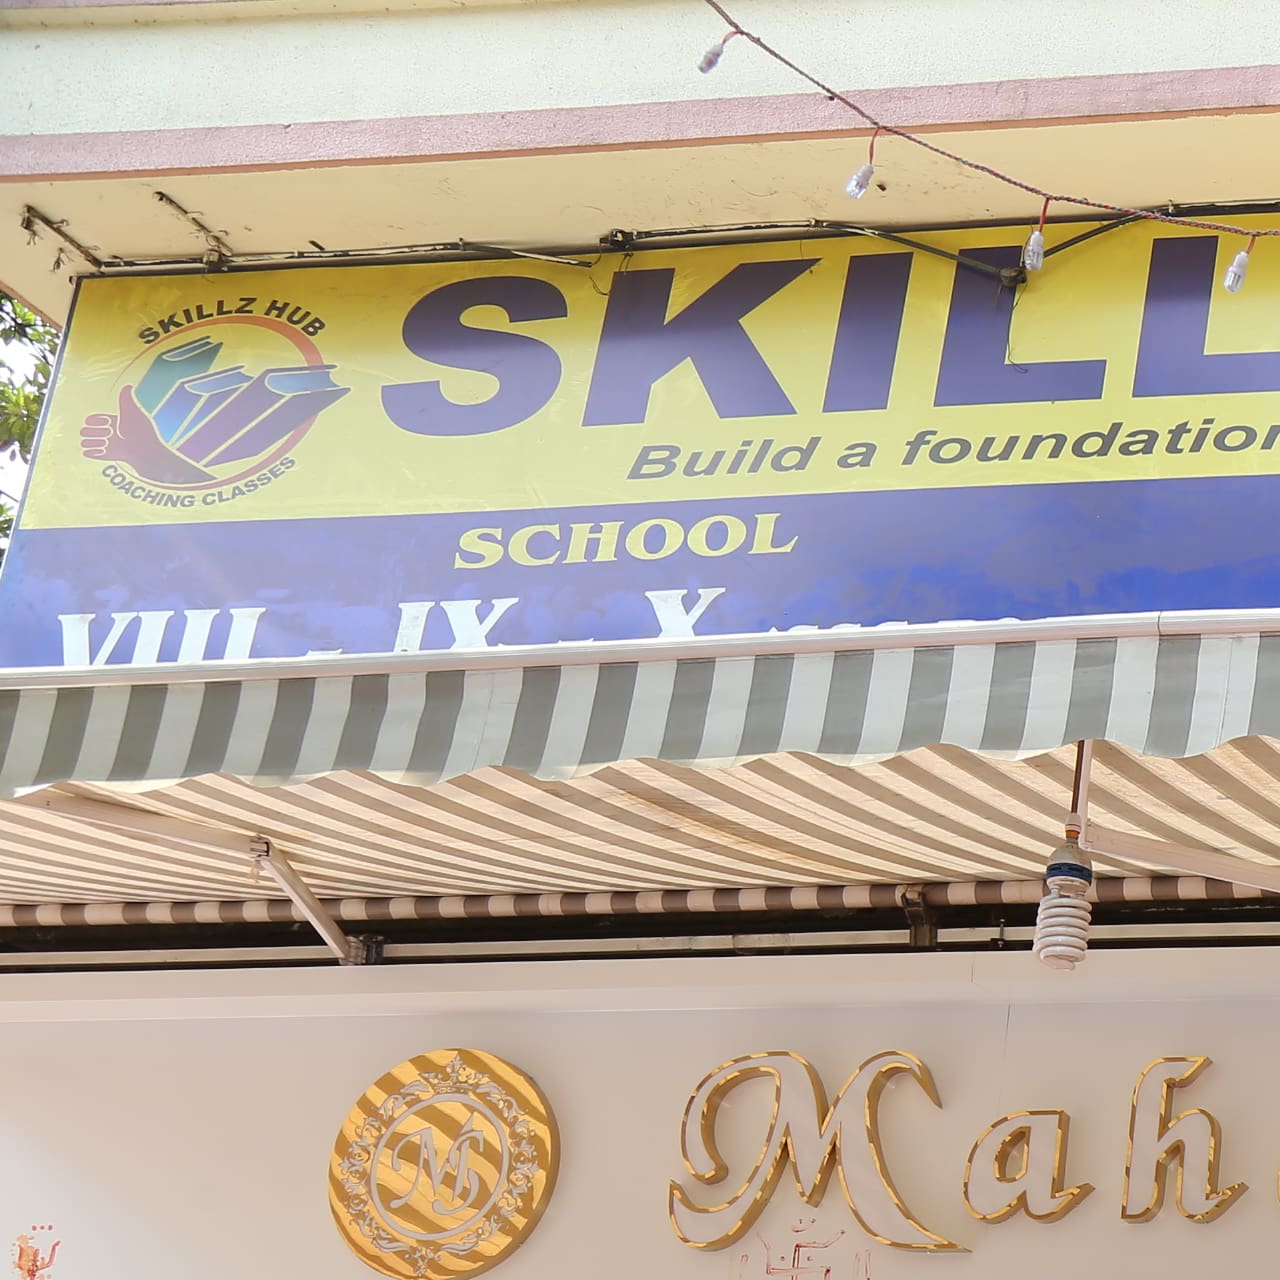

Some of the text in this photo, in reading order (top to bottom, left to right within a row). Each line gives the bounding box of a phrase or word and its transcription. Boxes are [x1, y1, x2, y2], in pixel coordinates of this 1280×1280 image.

[138, 297, 326, 345] SKILLZ HUB
[101, 456, 296, 508] COACHING CLASSES
[627, 435, 822, 480] Build
[836, 438, 877, 470] a
[453, 512, 799, 571] SCHOOL
